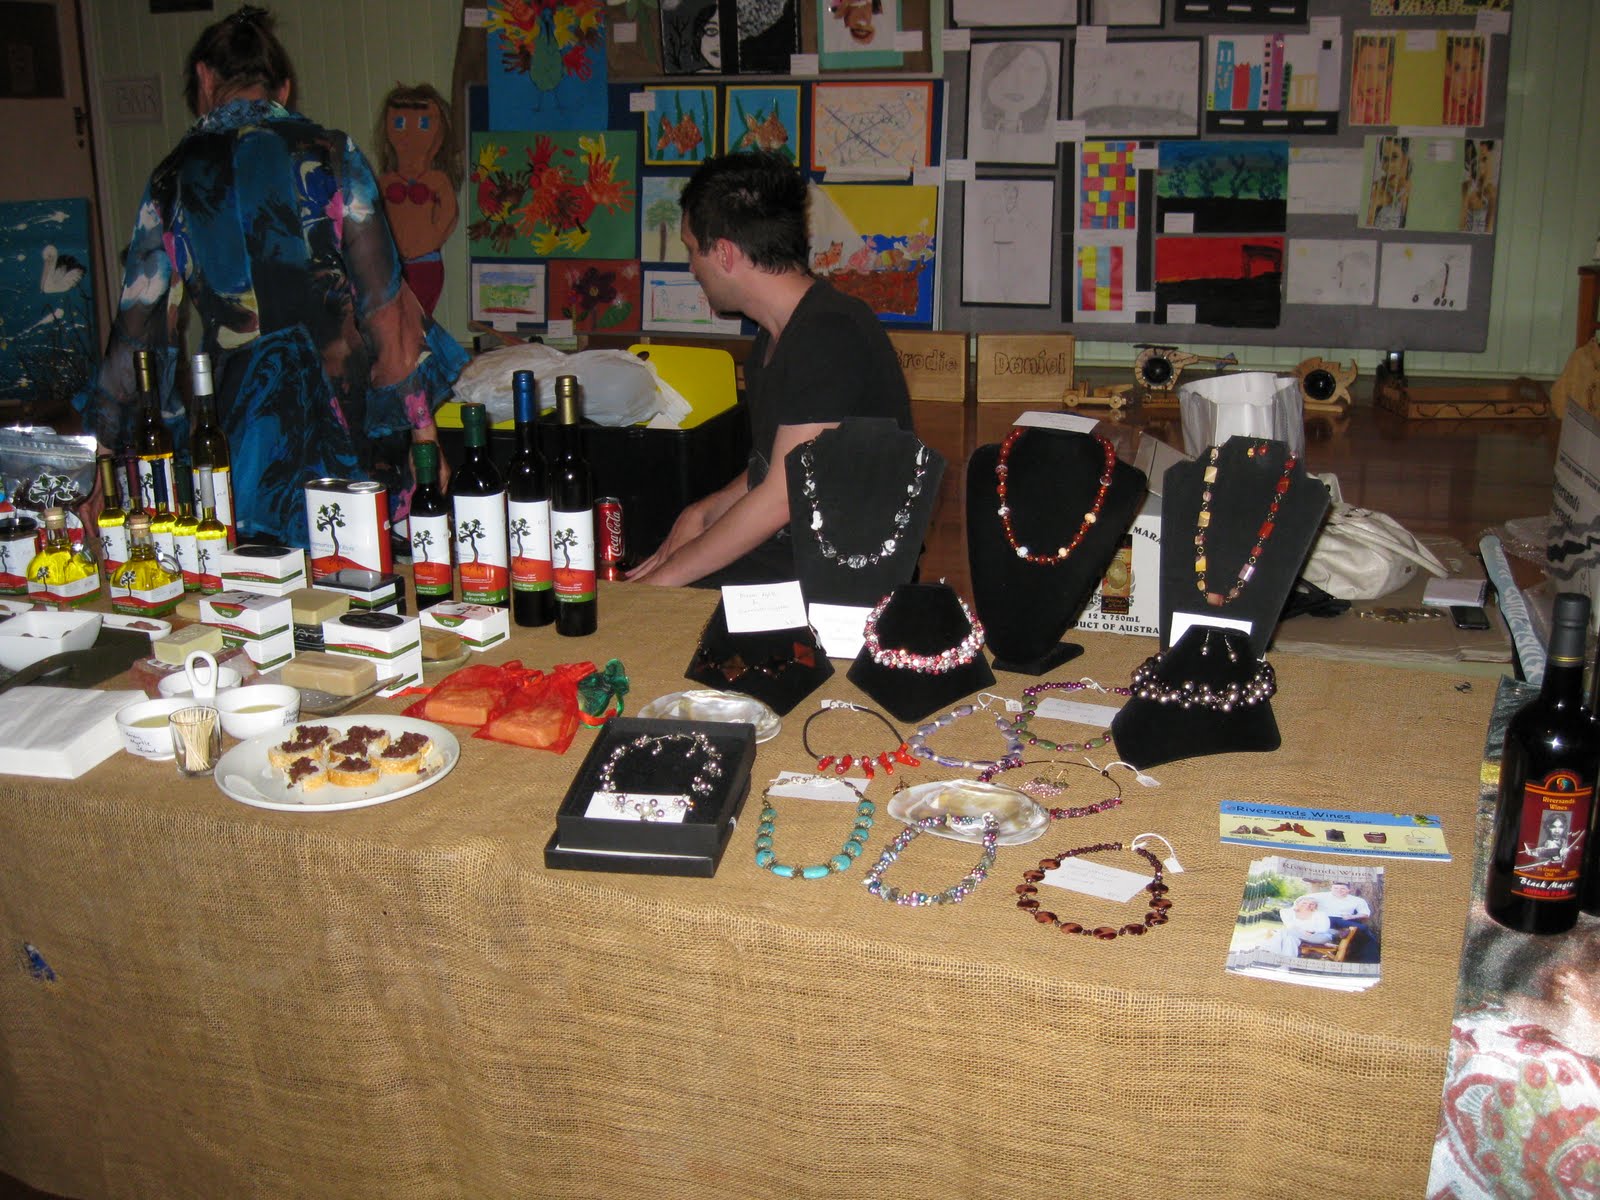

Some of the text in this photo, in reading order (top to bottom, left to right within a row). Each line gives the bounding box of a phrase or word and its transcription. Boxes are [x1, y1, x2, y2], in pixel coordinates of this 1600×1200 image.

[994, 350, 1067, 376] Daniel
[1110, 614, 1141, 623] 750mL
[1102, 622, 1116, 630] OF
[1118, 624, 1160, 634] AUSTRA
[1236, 805, 1351, 820] Riversands Wines
[1282, 861, 1336, 875] Riversands
[1339, 869, 1372, 877] Wines
[1519, 876, 1574, 890] Black Magic
